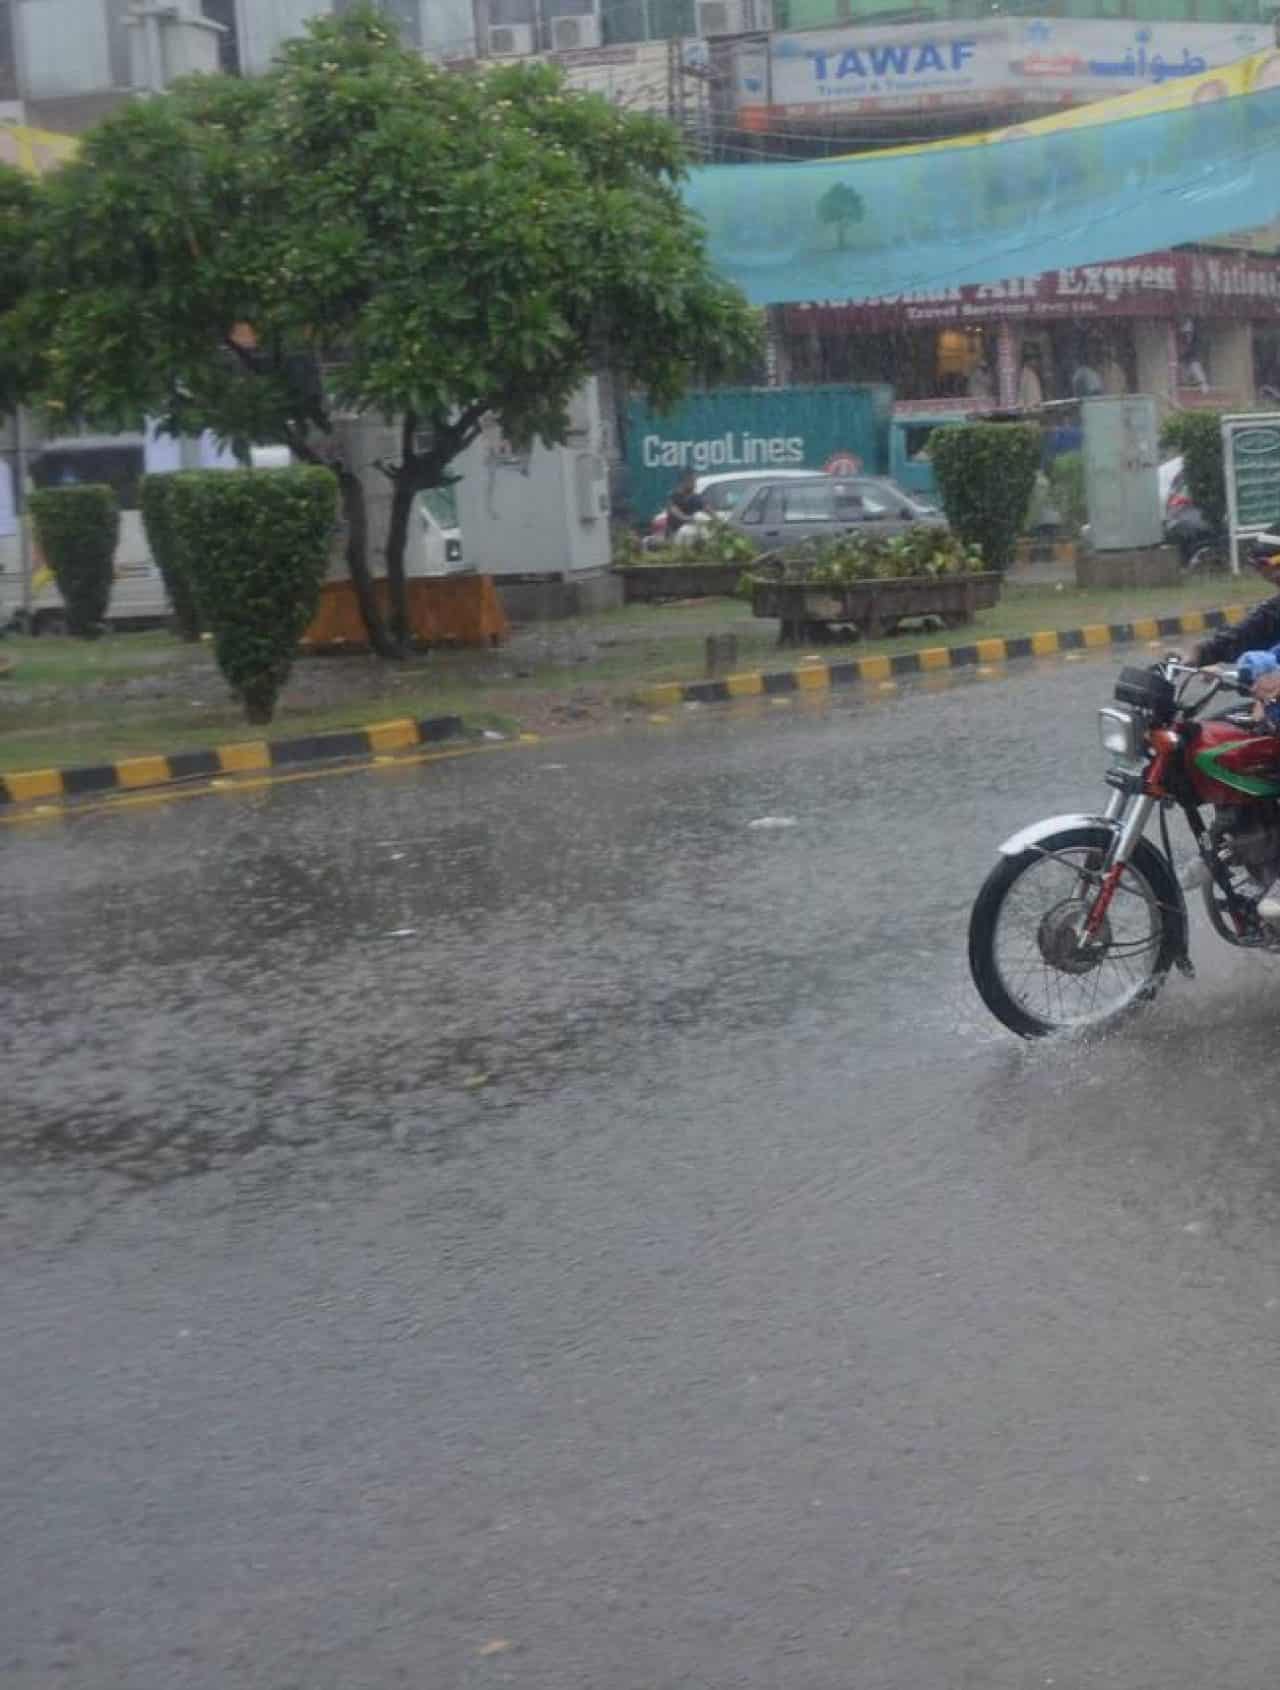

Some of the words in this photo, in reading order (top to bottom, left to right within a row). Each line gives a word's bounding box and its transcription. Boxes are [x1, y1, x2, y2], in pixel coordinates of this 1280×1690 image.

[805, 40, 977, 81] TAWAF
[1055, 264, 1177, 301] Express
[642, 431, 805, 471] CargoLines
